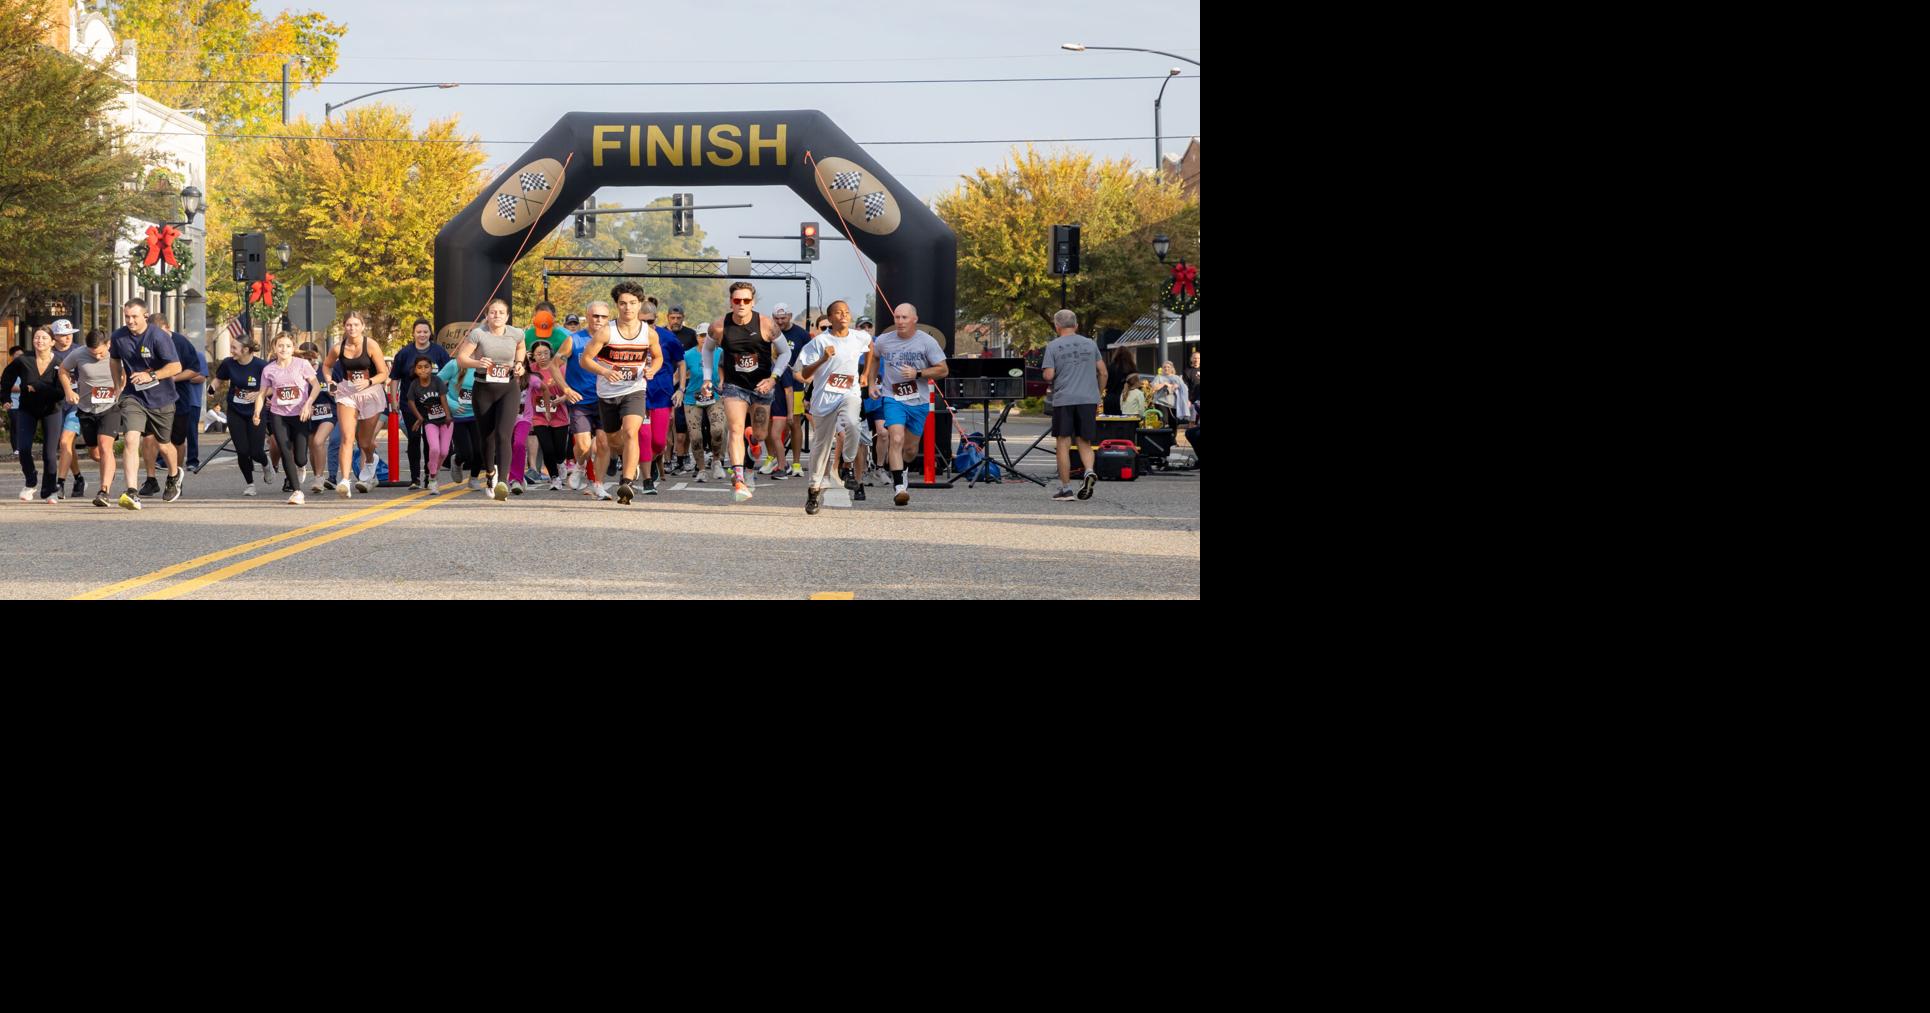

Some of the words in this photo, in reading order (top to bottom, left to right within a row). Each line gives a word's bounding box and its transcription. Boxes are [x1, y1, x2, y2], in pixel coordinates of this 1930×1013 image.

[592, 124, 787, 167] FINISH
[740, 358, 754, 368] 365
[492, 367, 505, 377] 360
[832, 377, 848, 388] 374
[96, 390, 110, 399] 372
[280, 390, 296, 400] 304
[898, 385, 913, 396] 313
